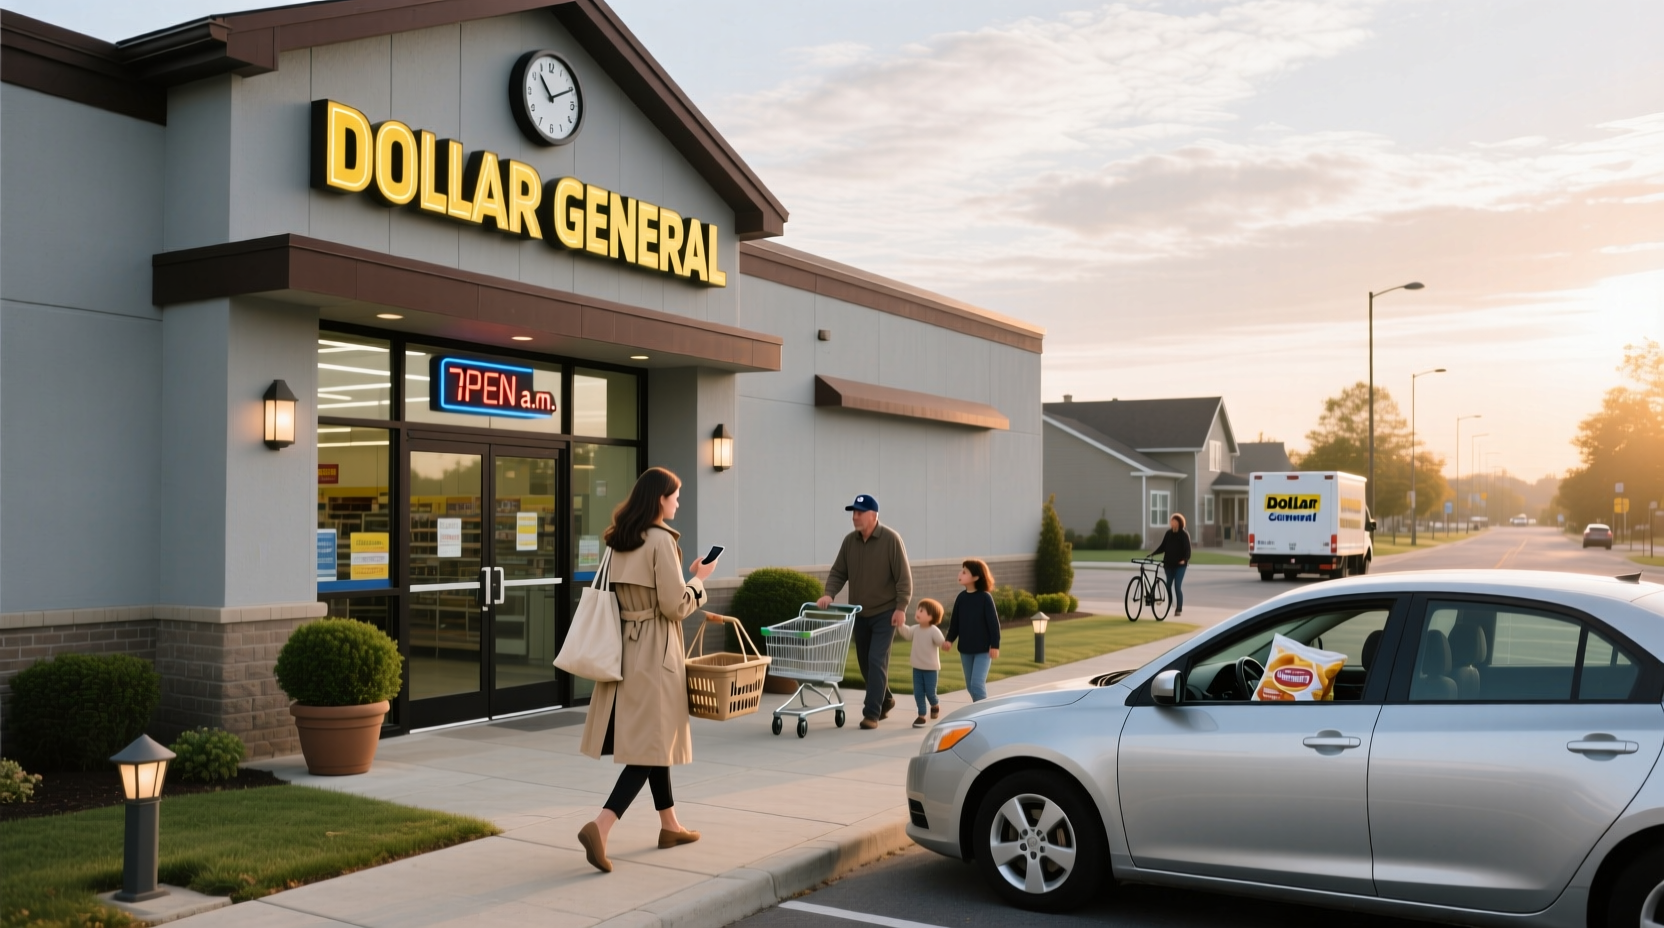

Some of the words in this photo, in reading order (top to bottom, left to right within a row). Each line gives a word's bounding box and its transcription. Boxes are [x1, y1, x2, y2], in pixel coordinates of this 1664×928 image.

[326, 100, 543, 240] DOLLAR
[553, 176, 728, 288] GENERAL
[520, 389, 556, 411] a.m.
[1266, 496, 1318, 510] Dollar
